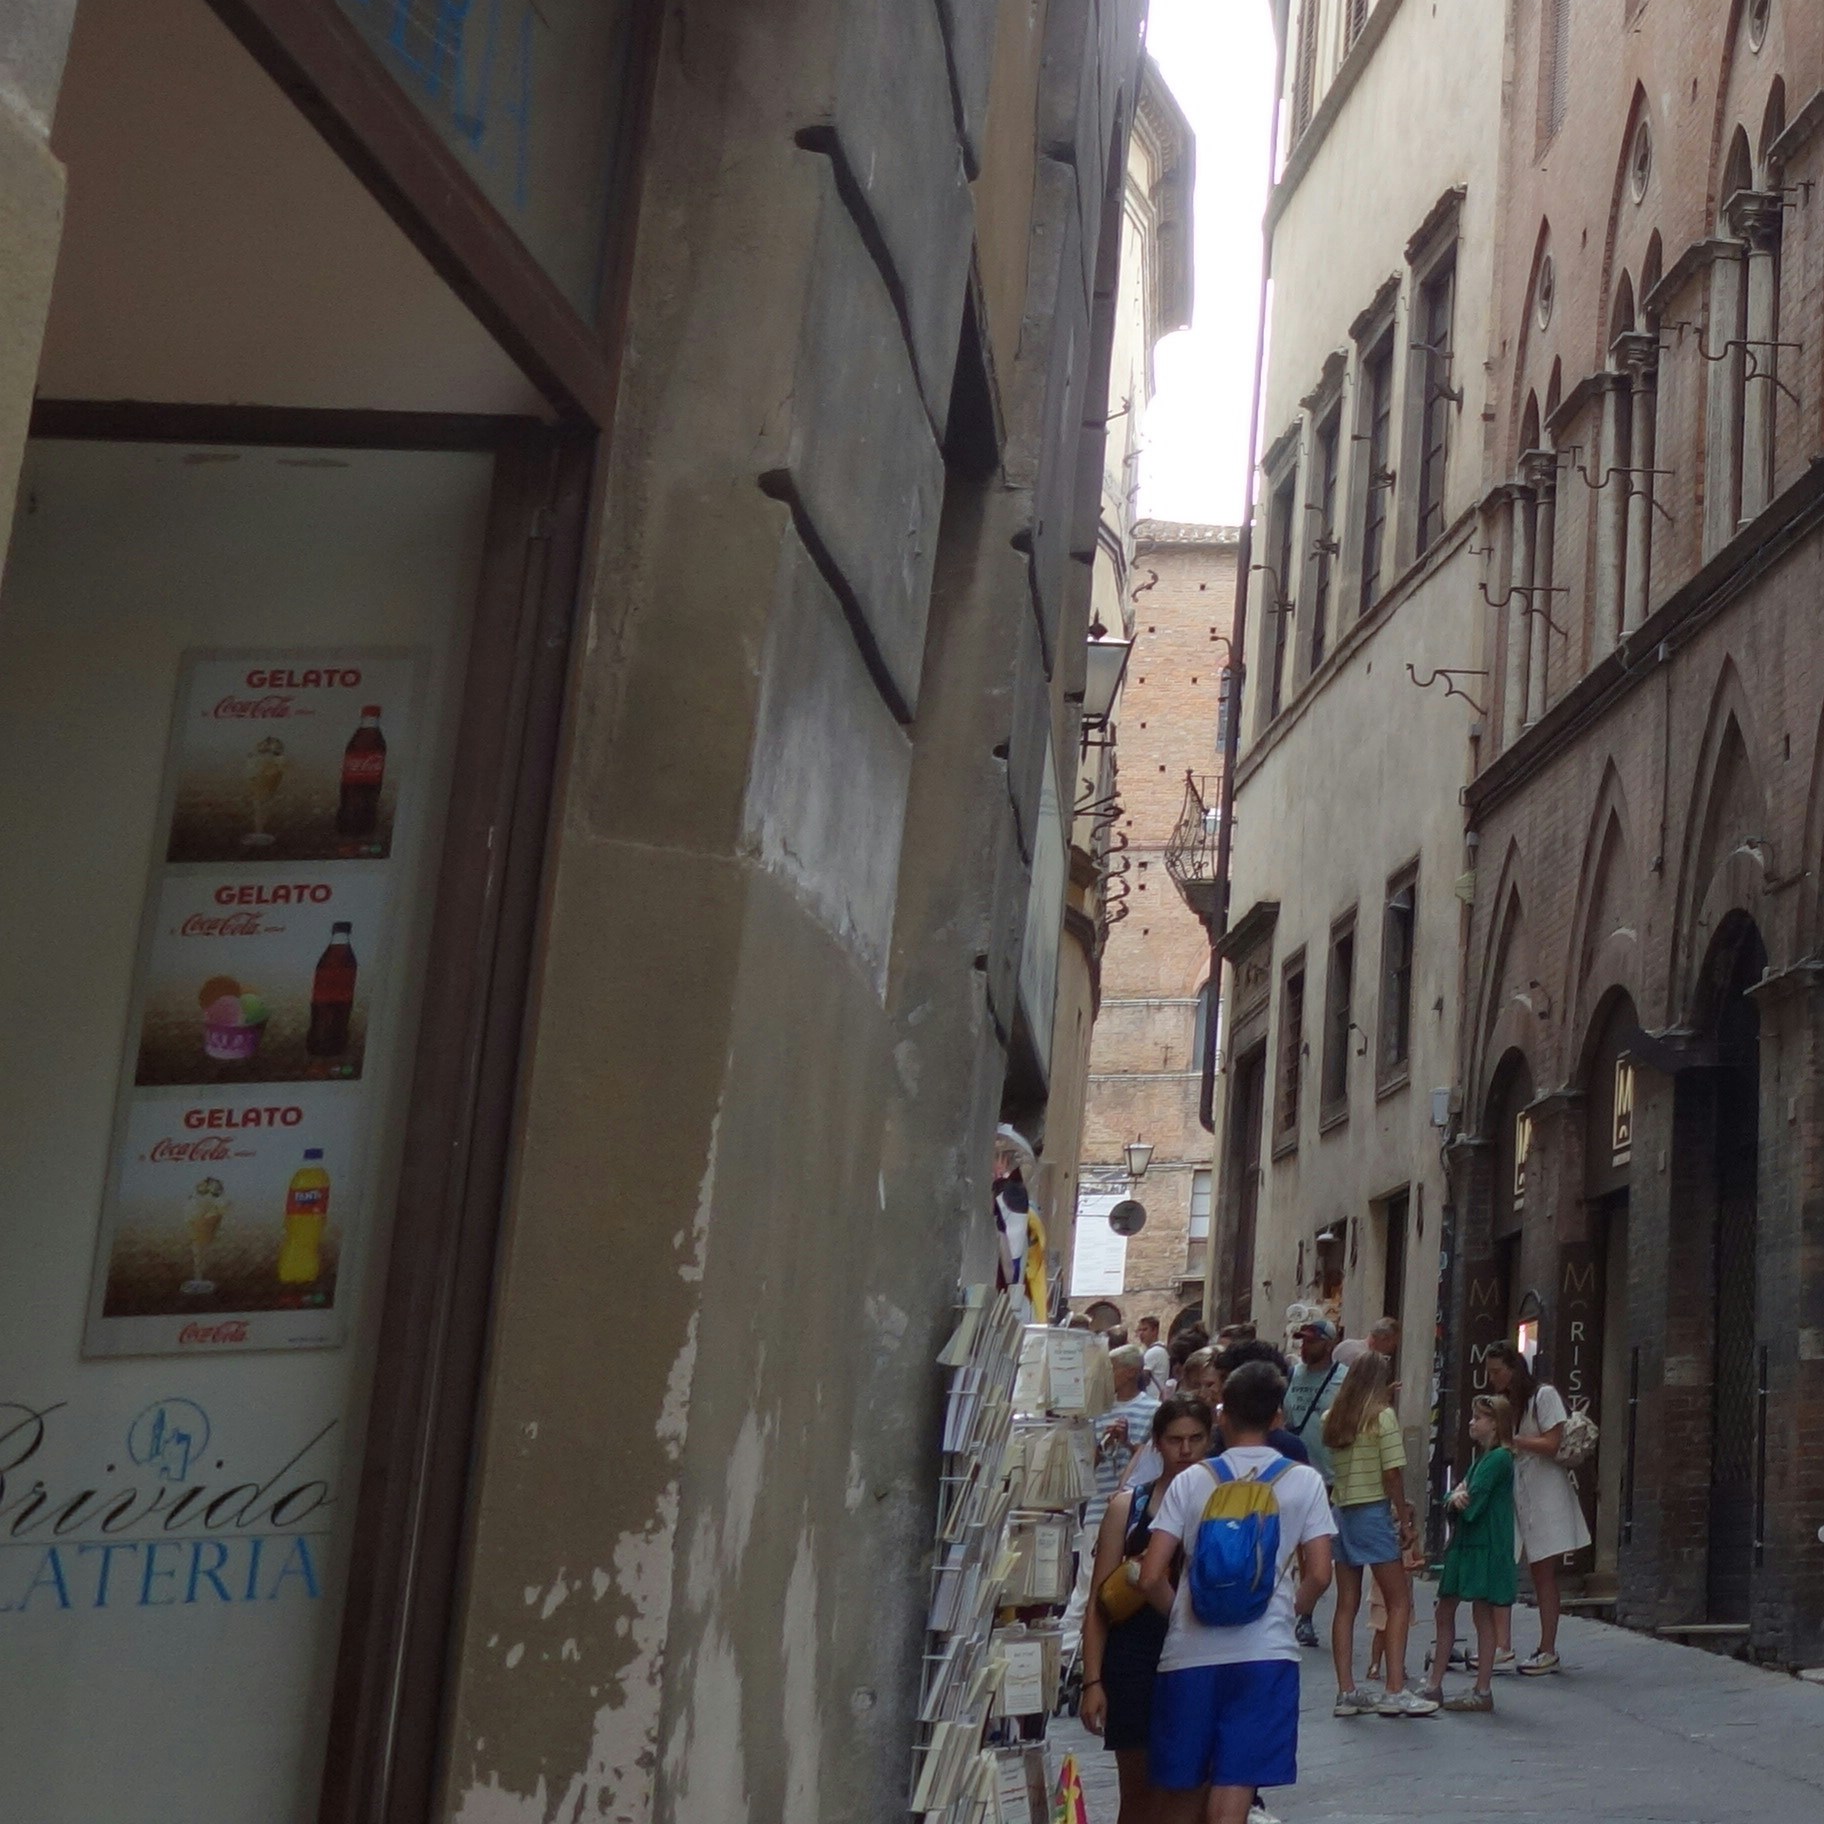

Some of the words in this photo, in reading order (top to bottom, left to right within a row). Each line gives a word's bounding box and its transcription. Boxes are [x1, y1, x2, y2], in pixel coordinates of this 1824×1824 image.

[246, 669, 362, 689] GELATO
[214, 884, 333, 905] GELATO
[184, 1106, 303, 1129] GELATO
[0, 1536, 321, 1613] ATERIA
